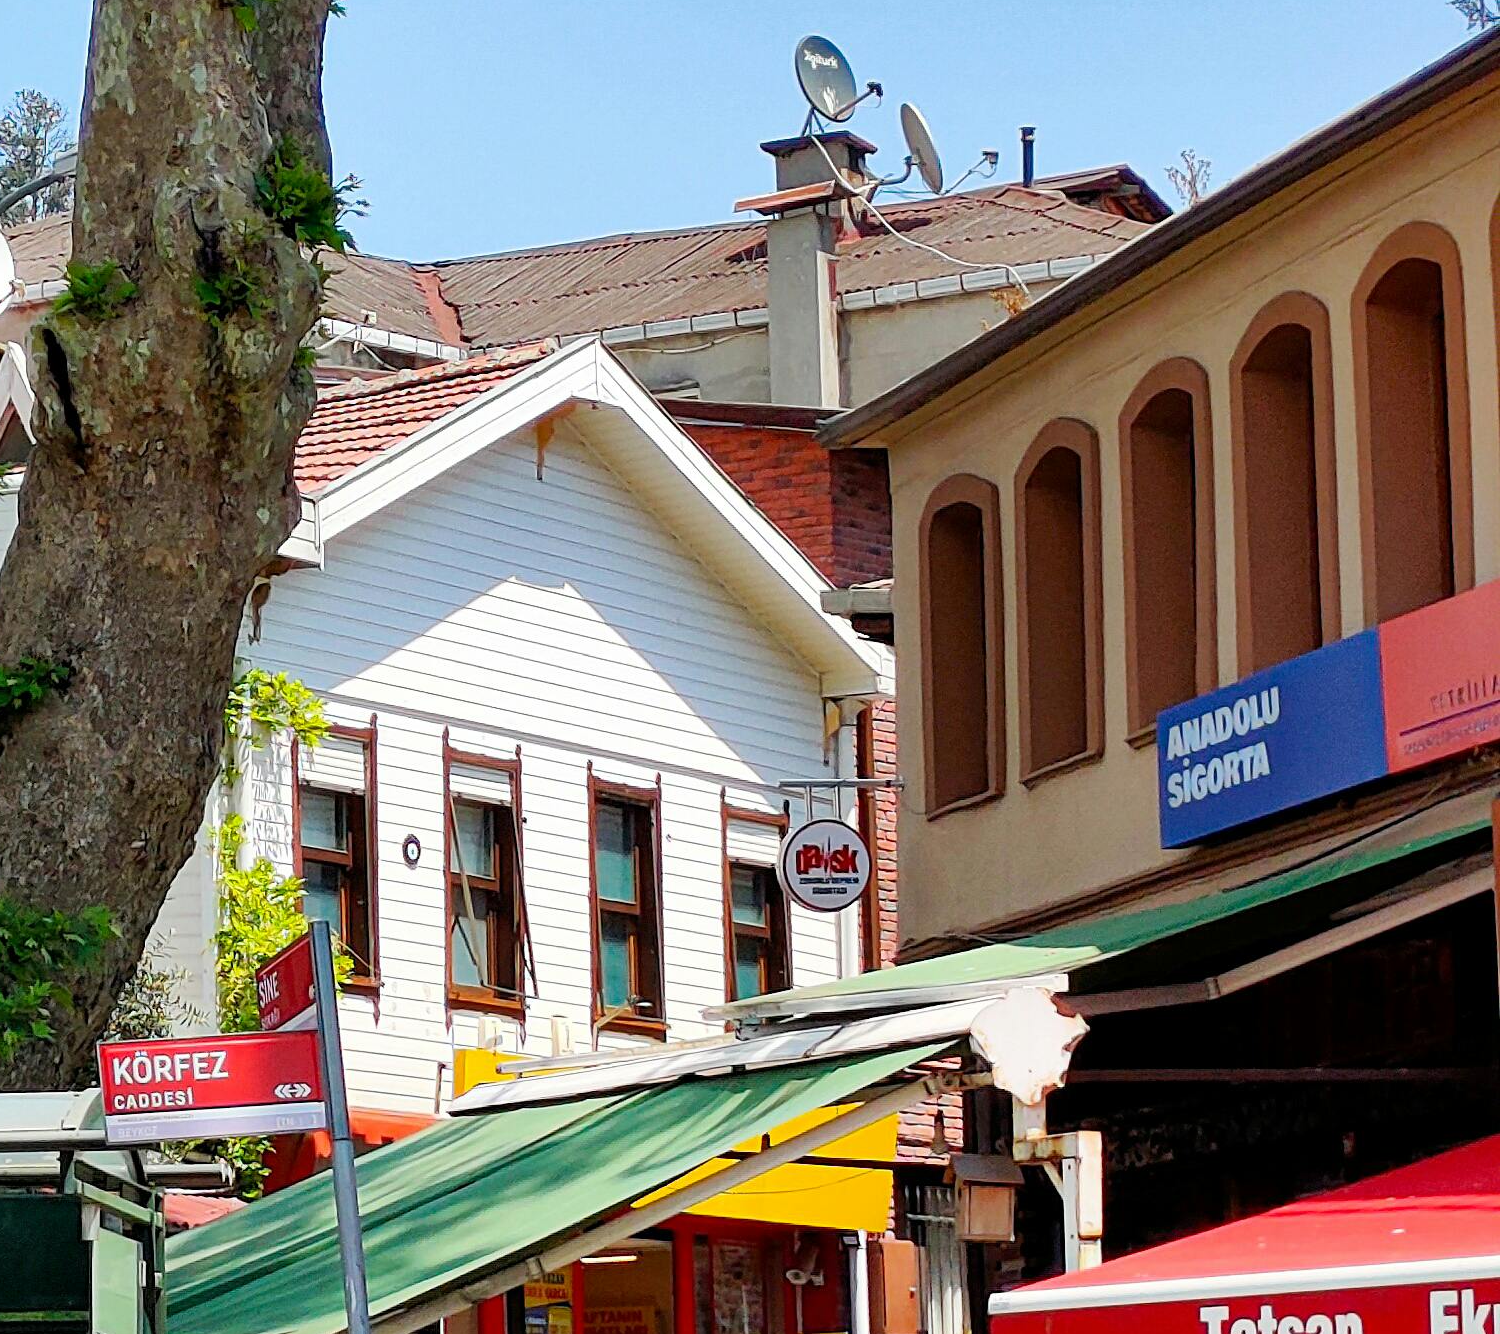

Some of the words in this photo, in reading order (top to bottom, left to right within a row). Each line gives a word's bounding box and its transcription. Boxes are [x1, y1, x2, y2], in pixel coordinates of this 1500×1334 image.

[1166, 686, 1281, 761] ANADOLU
[1167, 741, 1270, 808] SİGORTA
[112, 1049, 230, 1086] KÖRFEZ
[112, 1086, 194, 1110] CADDESİ
